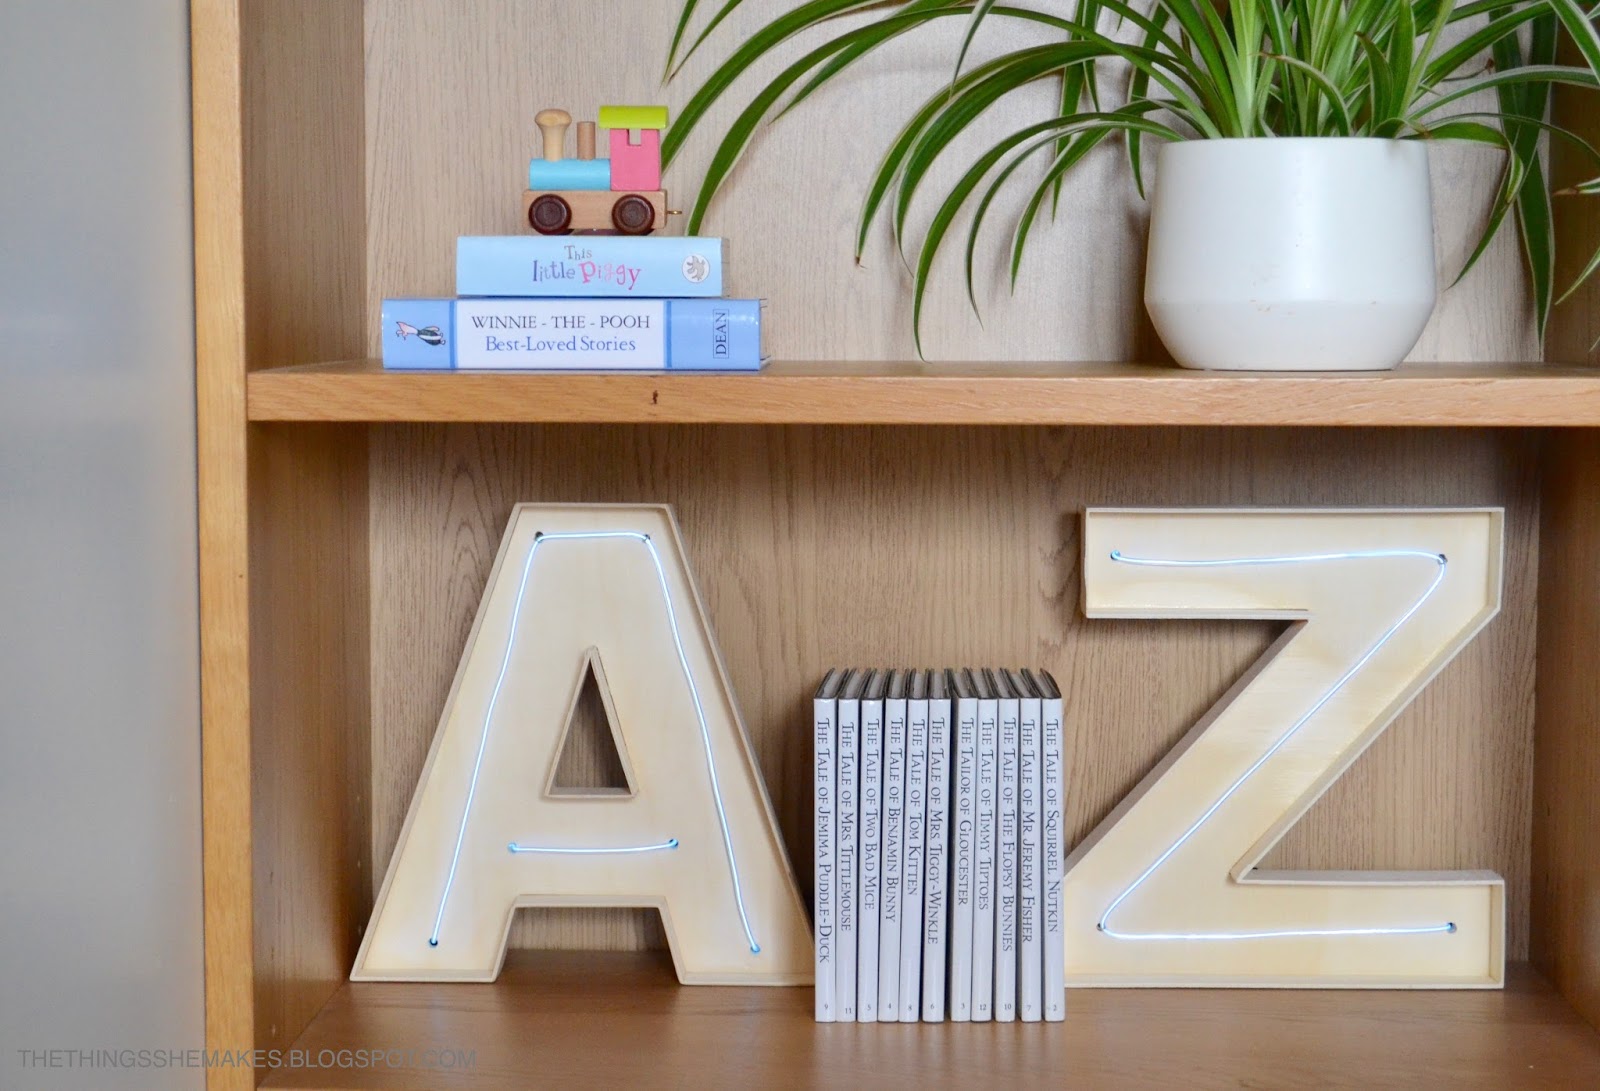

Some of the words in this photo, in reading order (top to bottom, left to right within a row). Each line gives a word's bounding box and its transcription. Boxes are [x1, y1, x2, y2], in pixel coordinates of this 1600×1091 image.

[564, 245, 592, 261] This
[532, 260, 576, 282] little
[471, 315, 537, 329] WINNIE
[550, 315, 586, 329] THE
[600, 315, 650, 329] POOH
[715, 312, 727, 355] DEAN
[486, 336, 576, 351] Best-Loved
[580, 335, 636, 351] Stories
[818, 718, 830, 744] THE
[842, 722, 854, 747] THE
[867, 719, 879, 745] THE
[891, 718, 903, 743] THE
[912, 719, 925, 746] THE
[932, 717, 944, 743] THE
[962, 718, 974, 743] THE
[982, 719, 994, 745] THE
[1004, 718, 1016, 744] THE
[1023, 720, 1035, 746] THE
[1046, 719, 1058, 745] THE
[818, 749, 830, 782] TALE
[842, 752, 854, 785] TALE
[866, 750, 879, 783] TALE
[890, 748, 902, 781] TALE
[911, 751, 924, 785] TALE
[931, 748, 944, 782] TALE
[961, 747, 973, 795] TAILOR
[981, 750, 993, 783] TALE
[1003, 748, 1016, 782] TALE
[1023, 750, 1034, 784] TALE
[1046, 750, 1058, 783] TALE
[818, 787, 828, 803] OF
[842, 791, 851, 807] OF
[866, 788, 876, 805] OF
[889, 787, 899, 803] OF
[910, 790, 921, 807] OF
[931, 787, 941, 804] OF
[960, 798, 970, 815] OF
[981, 789, 991, 806] OF
[1003, 787, 1013, 804] OF
[1023, 789, 1033, 806] OF
[1047, 789, 1056, 806] OF
[818, 807, 830, 858] JEMIMA
[865, 809, 877, 838] TWO
[910, 813, 922, 839] TOM
[980, 810, 992, 852] TIMMY
[1003, 810, 1015, 836] THE
[887, 808, 900, 872] BENJAMIN
[1046, 810, 1059, 875] SQUIRREL
[865, 843, 877, 871] BAD
[908, 846, 921, 895] KITTEN
[958, 820, 972, 906] GLOUCESTER
[1003, 842, 1015, 890] FLOPSY
[1022, 839, 1034, 891] JEREMY
[841, 845, 853, 931] TITTLEMOUSE
[865, 876, 876, 910] MICE
[928, 844, 942, 944] TIGGY-WINKLE
[979, 858, 991, 910] TIPTOES
[819, 864, 832, 963] PUDDLE-DUCK
[886, 877, 898, 923] BUNNY
[1048, 880, 1060, 932] NUTKIN
[1002, 896, 1014, 952] BUNNIES
[1023, 896, 1035, 942] FISHER
